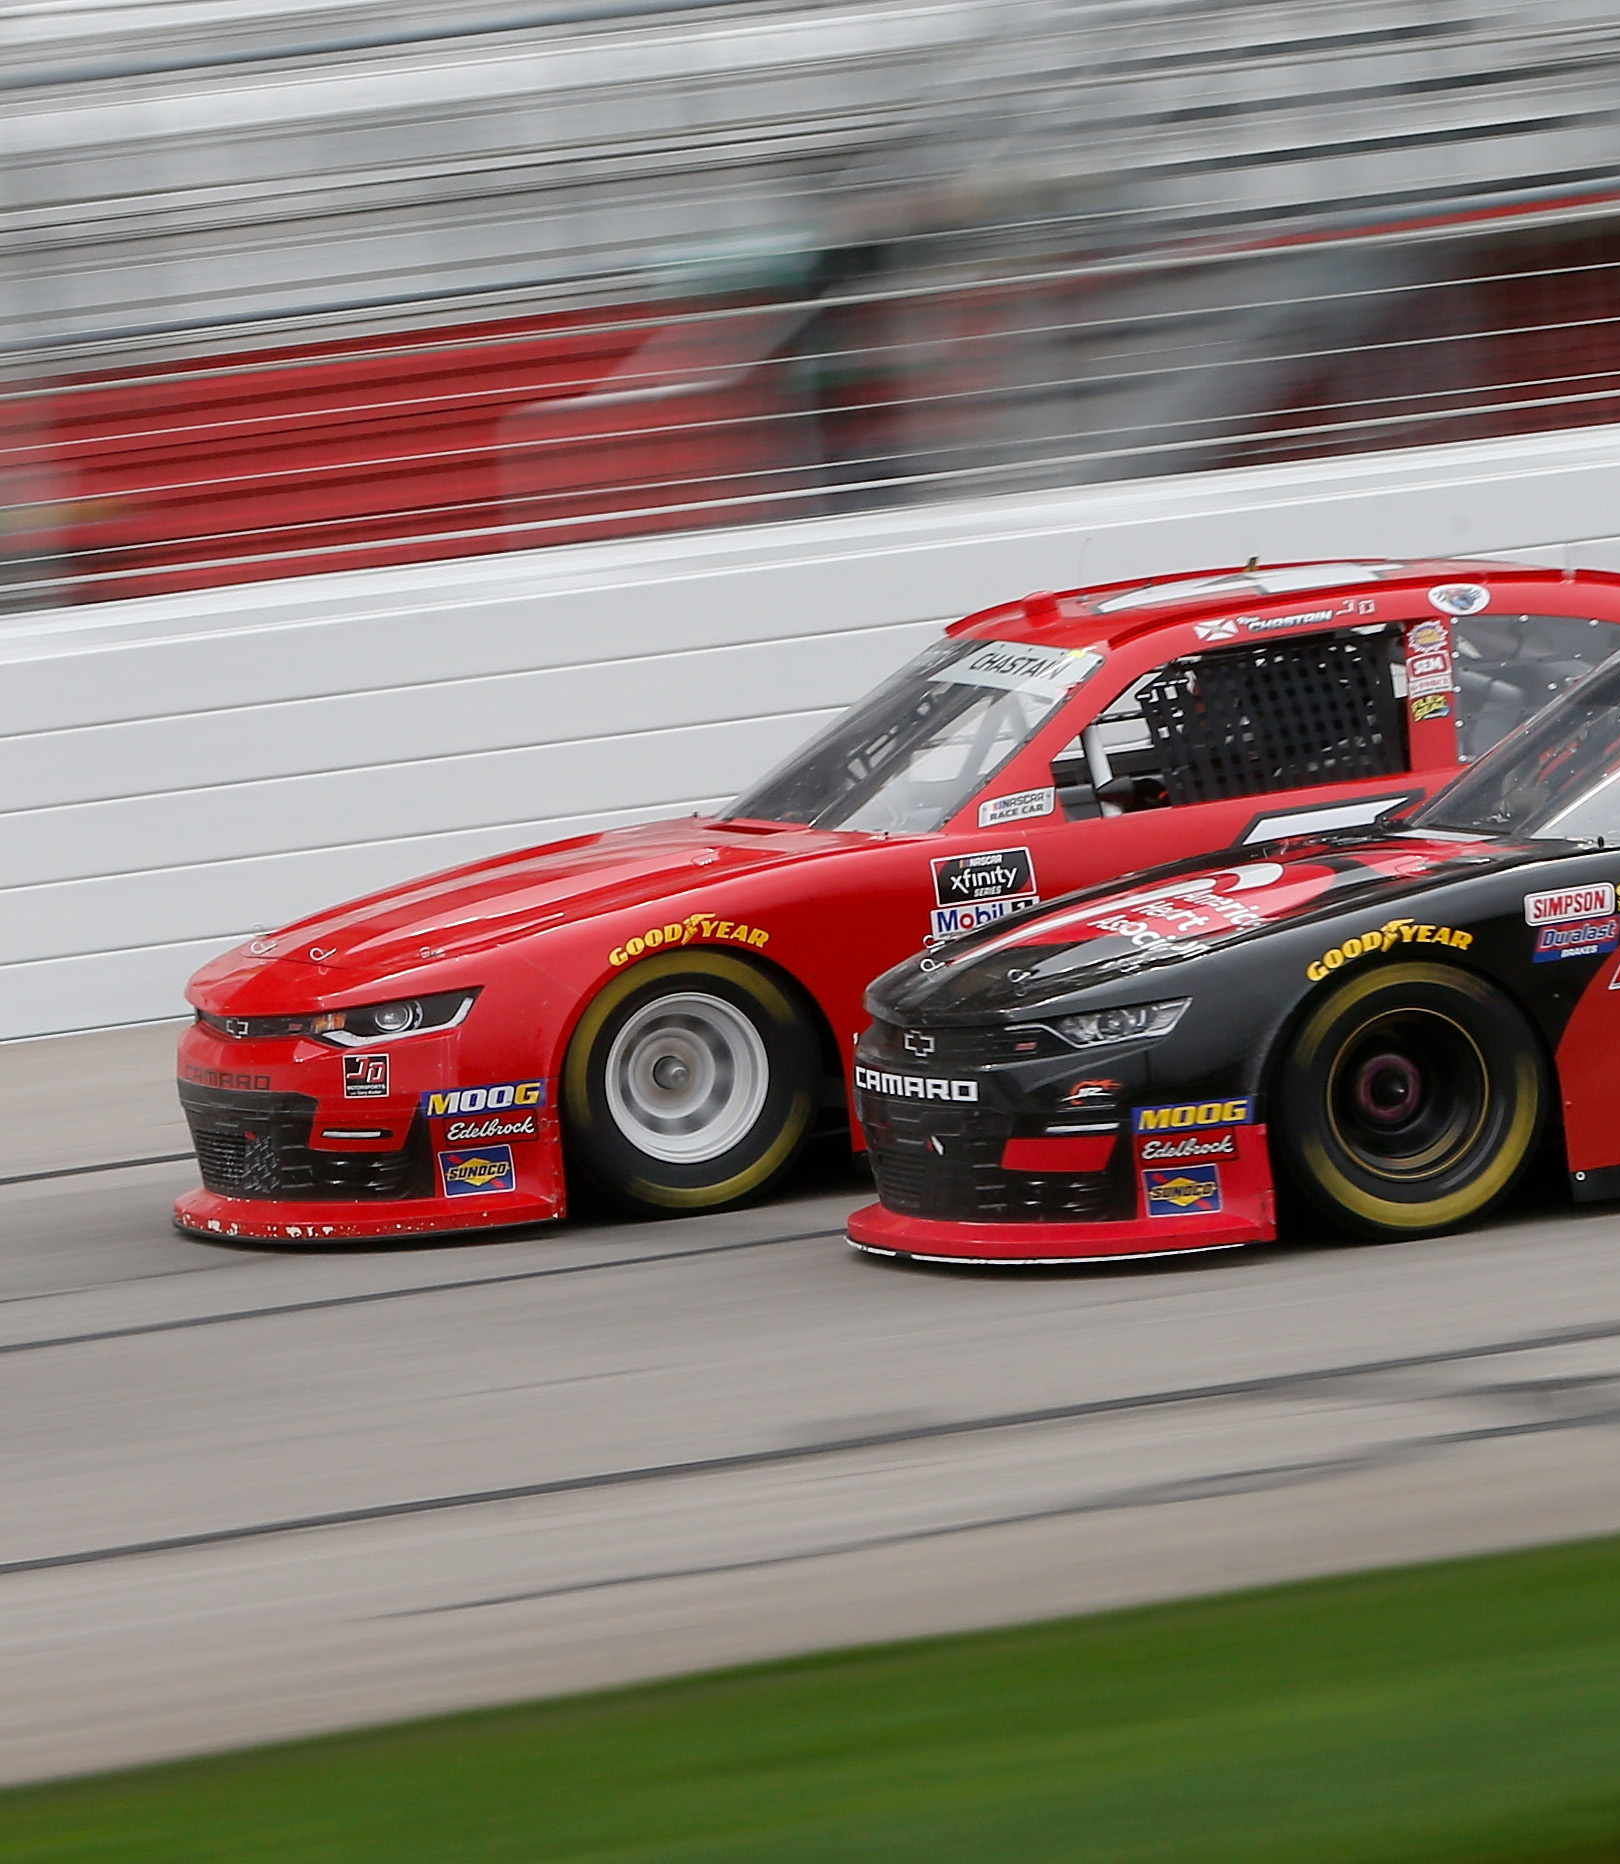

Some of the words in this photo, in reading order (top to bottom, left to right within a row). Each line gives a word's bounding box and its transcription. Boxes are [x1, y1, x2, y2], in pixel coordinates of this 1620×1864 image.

[989, 808, 1019, 821] RACE
[1021, 803, 1044, 815] CAR
[1002, 792, 1044, 808] NASCAR
[969, 854, 1003, 868] NASCAR
[950, 866, 1018, 894] xfinity
[973, 886, 1002, 897] SERIES
[1534, 889, 1606, 919] SIMPSON
[936, 903, 1004, 933] Mobil
[1541, 919, 1617, 948] Duralast
[1560, 945, 1599, 959] BRAKES
[184, 1065, 271, 1091] CAMARO
[855, 1065, 979, 1102] CAMARO
[426, 1082, 541, 1116] MOOG
[447, 1115, 535, 1141] Edelbrock
[1138, 1099, 1248, 1131] MOOG
[1141, 1134, 1235, 1160] Edelbrock
[448, 1162, 507, 1180] SUNOCO
